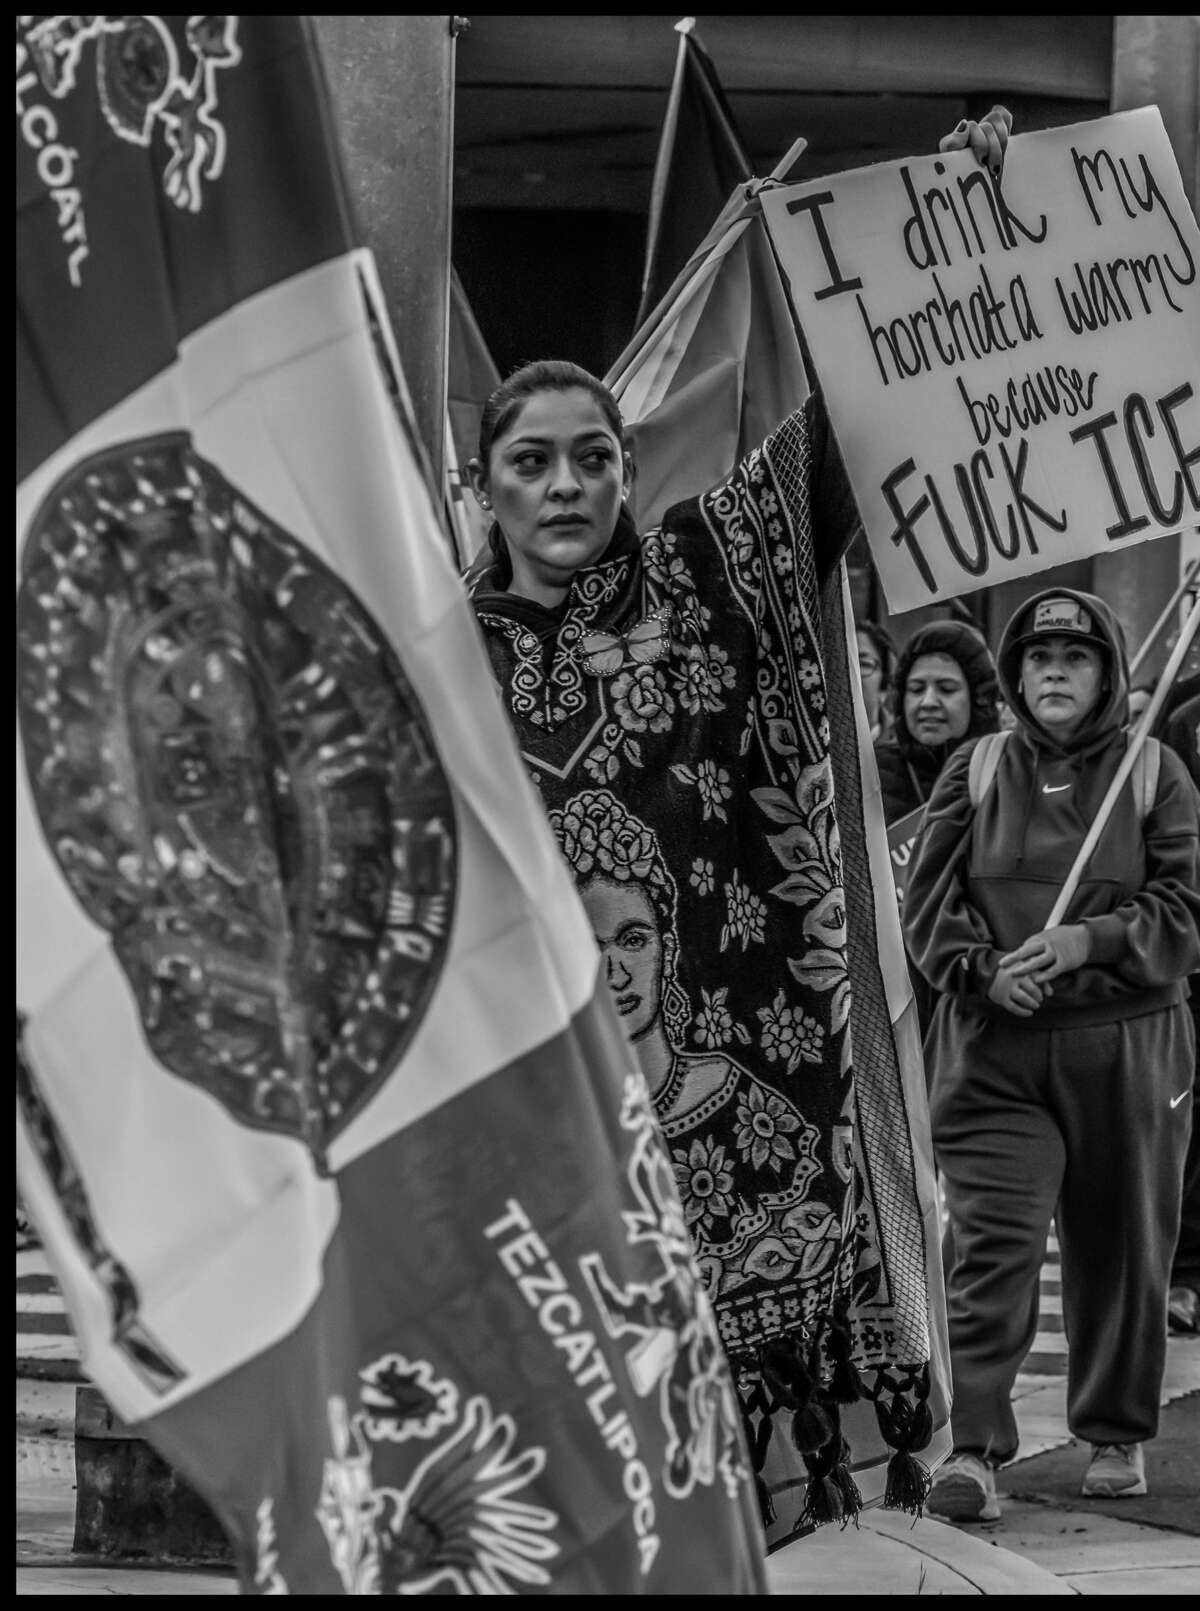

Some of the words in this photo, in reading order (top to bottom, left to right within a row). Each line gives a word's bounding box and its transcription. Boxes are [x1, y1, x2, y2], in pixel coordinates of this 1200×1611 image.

[786, 190, 864, 300] I
[900, 161, 1048, 270] drink
[856, 264, 1044, 385] horchata
[1056, 253, 1184, 336] warm
[957, 365, 1099, 446] because
[881, 438, 1068, 593] FUCK
[484, 1199, 661, 1575] TEZCATLIPOCA
